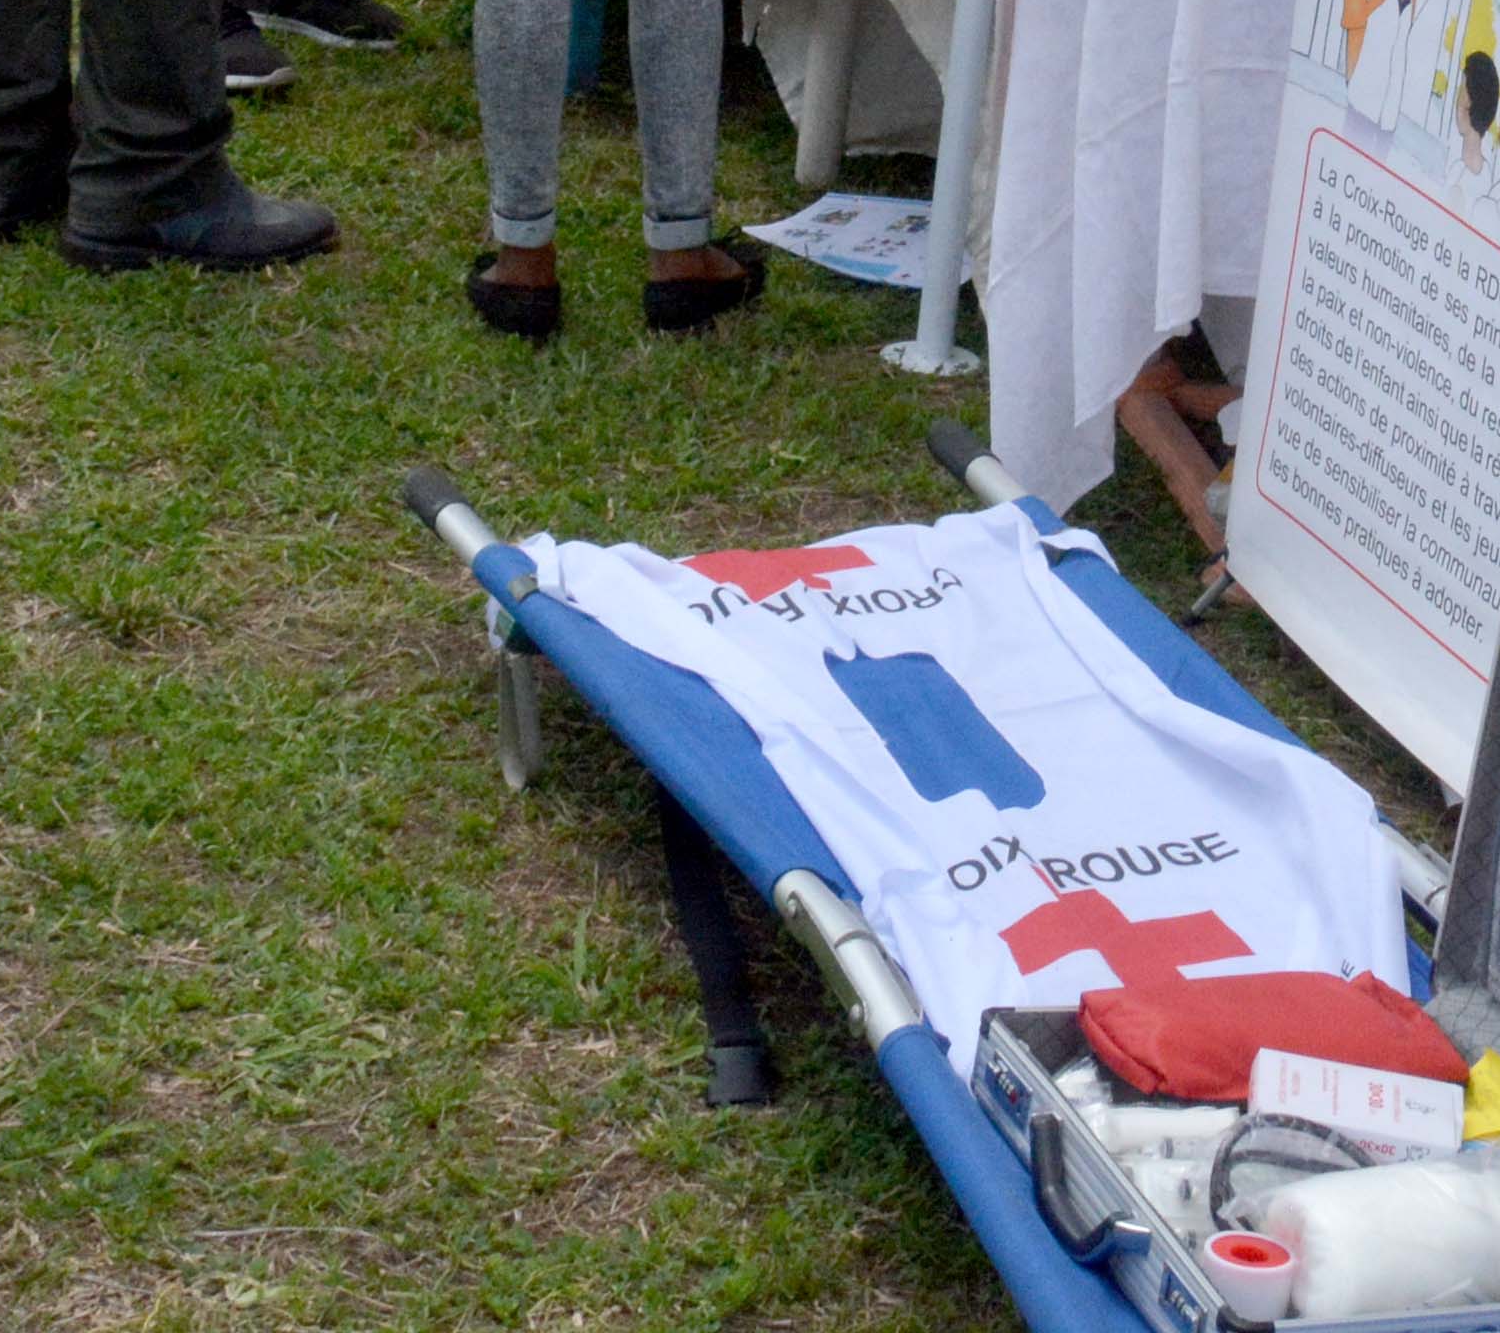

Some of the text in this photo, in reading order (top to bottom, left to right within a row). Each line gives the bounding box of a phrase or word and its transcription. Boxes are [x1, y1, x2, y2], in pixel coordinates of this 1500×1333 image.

[1312, 195, 1324, 219] à
[1329, 204, 1341, 233] la
[1346, 222, 1415, 285] promotion
[1420, 272, 1438, 302] de
[1445, 293, 1468, 325] ses
[1318, 157, 1337, 187] La
[1343, 174, 1429, 252] Croix-Rouge
[1434, 237, 1452, 268] de
[1457, 252, 1470, 281] la
[1295, 306, 1333, 351] droits
[1335, 335, 1353, 365] de
[1406, 391, 1438, 431] ainsi
[1440, 417, 1468, 454] que
[1471, 435, 1483, 465] la
[1301, 268, 1314, 295] la
[1315, 281, 1346, 319] paix
[1349, 302, 1363, 329] et
[1365, 318, 1455, 405] non-violence,
[1459, 387, 1478, 418] du
[1308, 236, 1357, 285] valeurs
[1361, 267, 1452, 361] humanitaires,
[1457, 343, 1476, 372] de
[1481, 357, 1495, 386] la
[1277, 418, 1301, 451] vue
[1303, 436, 1323, 466] de
[1324, 454, 1402, 531] sensibiliser
[1403, 513, 1417, 543] la
[1284, 382, 1427, 509] volontaires-diffuseurs
[1432, 497, 1446, 524] et
[1450, 506, 1471, 543] les
[1290, 343, 1314, 378] des
[1317, 366, 1366, 418] actions
[1369, 405, 1388, 434] de
[1390, 423, 1456, 487] proximité
[1459, 471, 1470, 497] à
[1269, 448, 1484, 645] les bonnes pratiques à adopter.
[947, 832, 1239, 892] OIX ROUGE
